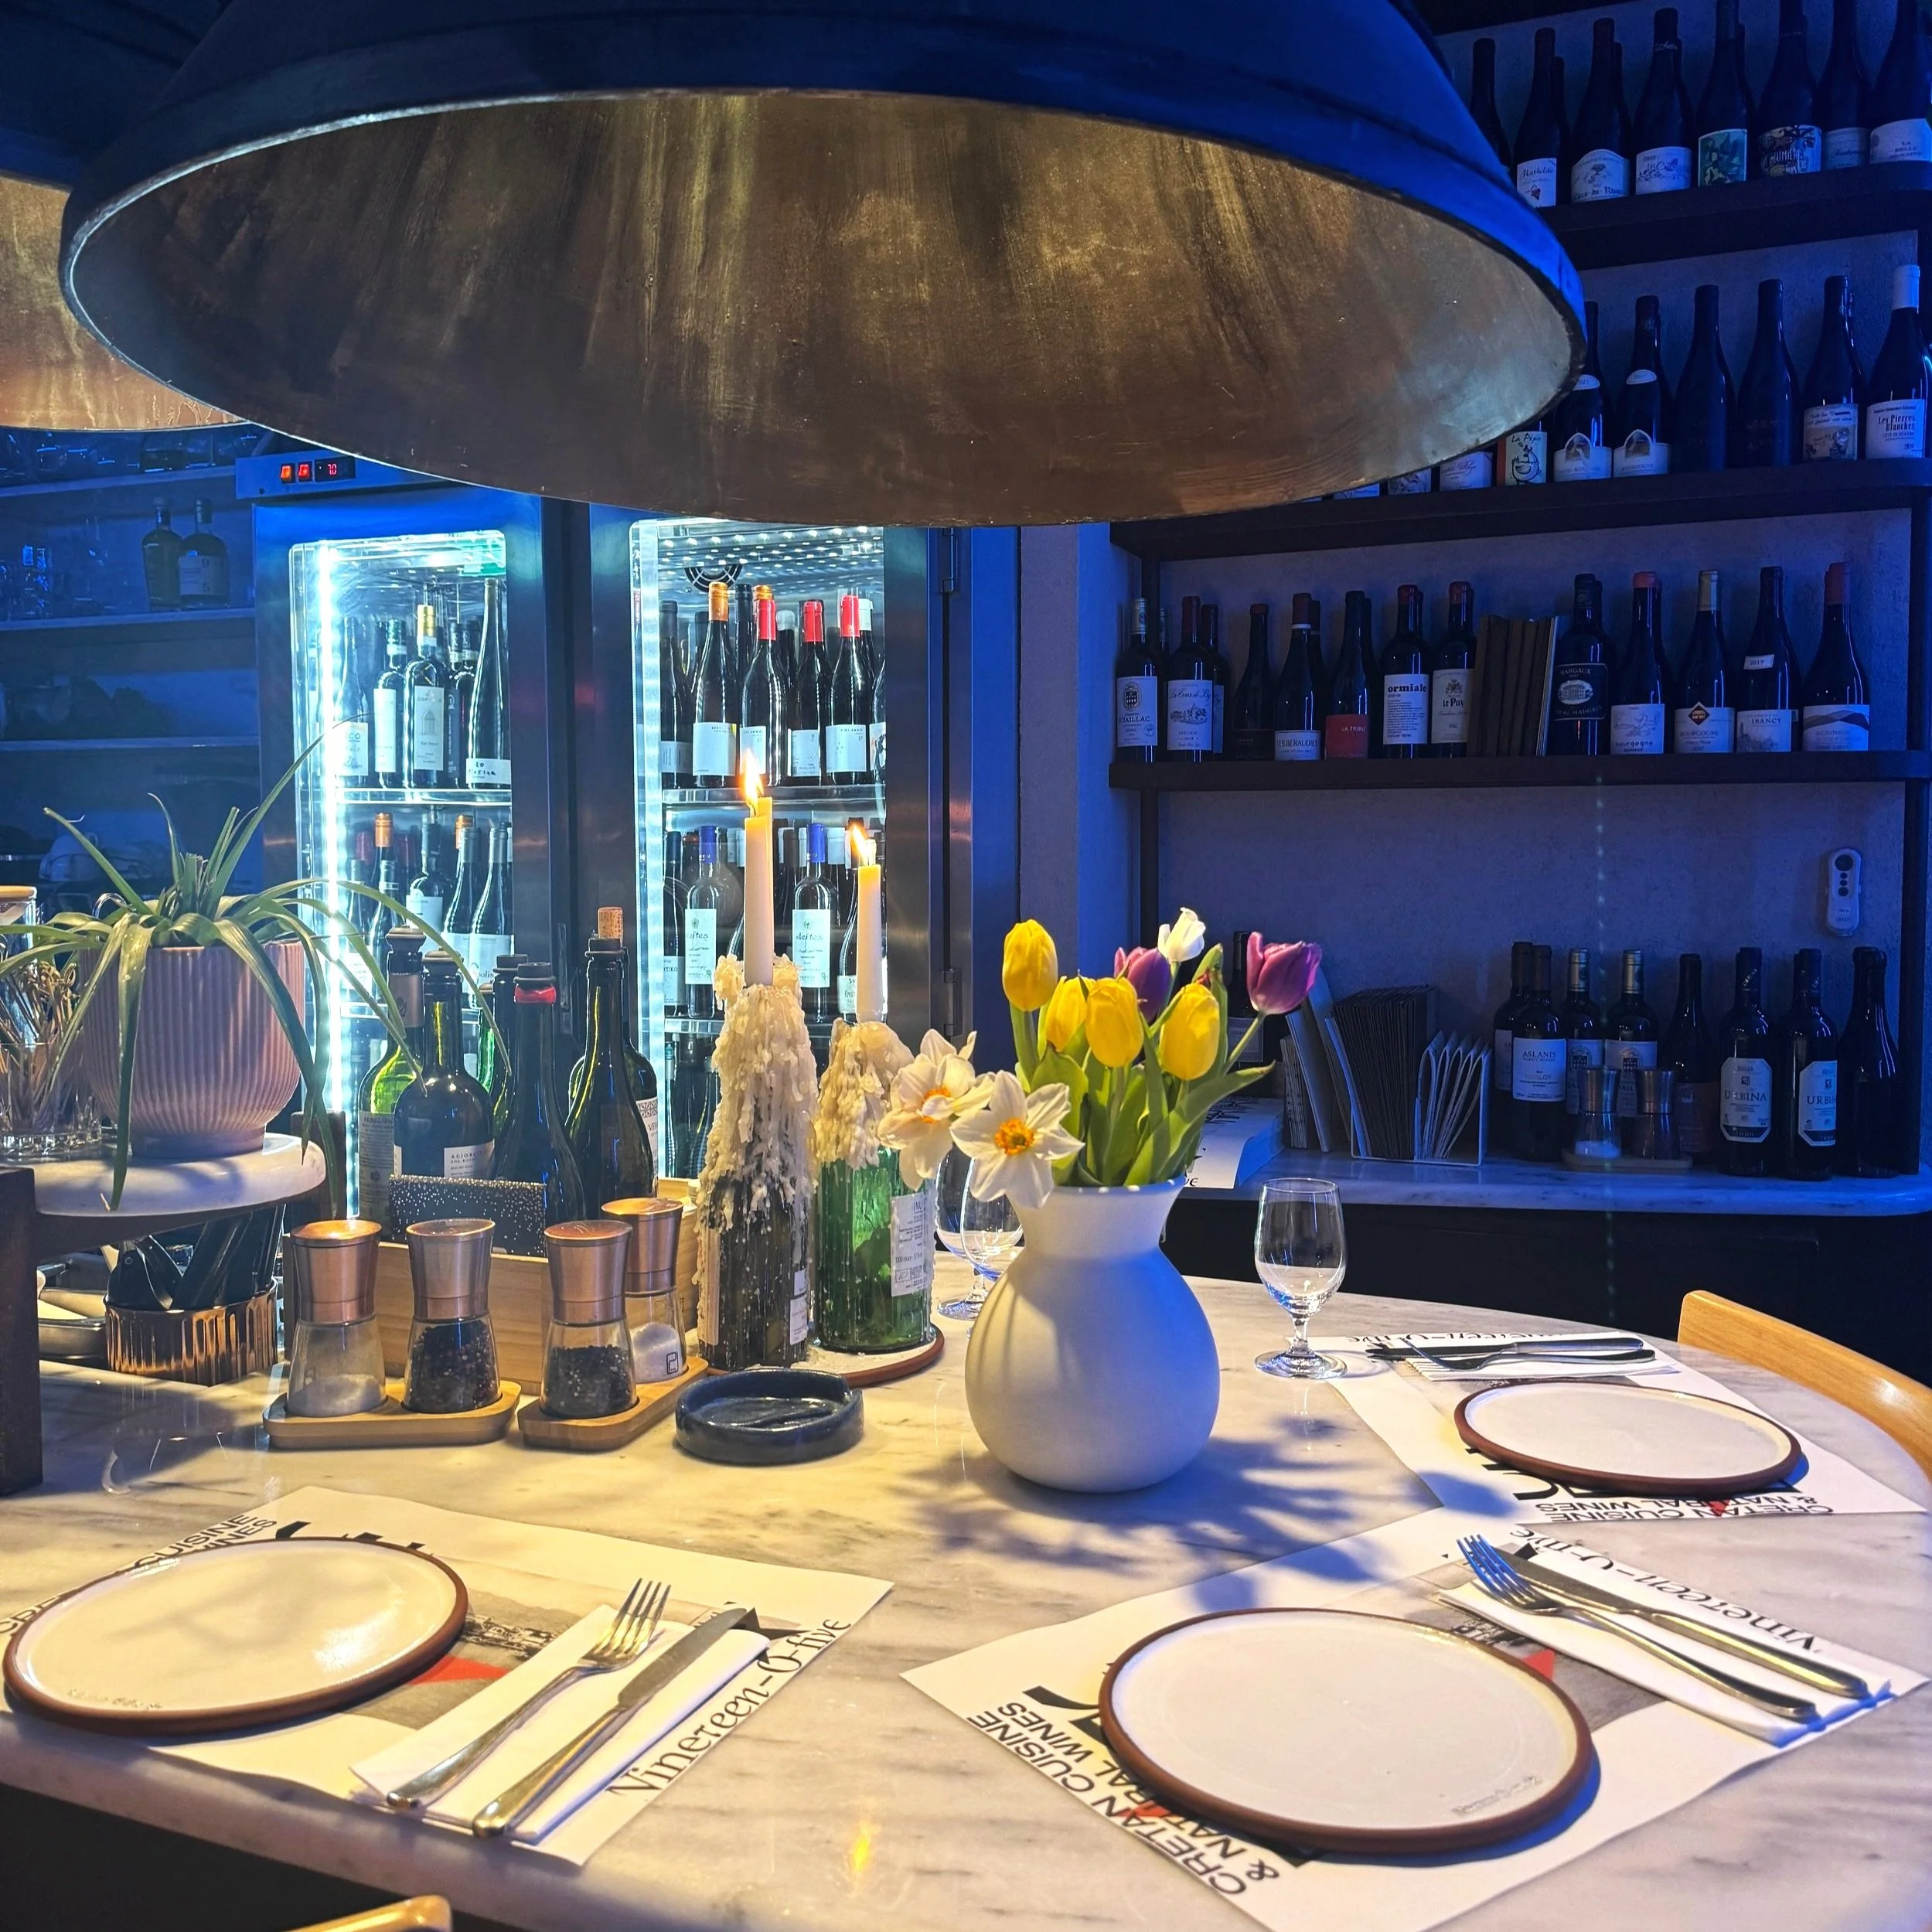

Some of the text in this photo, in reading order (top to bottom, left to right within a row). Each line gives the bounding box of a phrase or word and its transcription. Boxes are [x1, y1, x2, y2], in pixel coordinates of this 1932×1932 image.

[1521, 165, 1555, 178] Mathilde
[1388, 683, 1428, 693] ormiale
[1450, 697, 1465, 708] Puy
[1724, 1089, 1768, 1102] URBINA
[1535, 1501, 1641, 1511] WINES
[1547, 1507, 1685, 1522] CUISINE
[997, 1702, 1095, 1763] WINES
[966, 1710, 1247, 1896] CRETAN CUISINE
[1245, 1859, 1280, 1882] &
